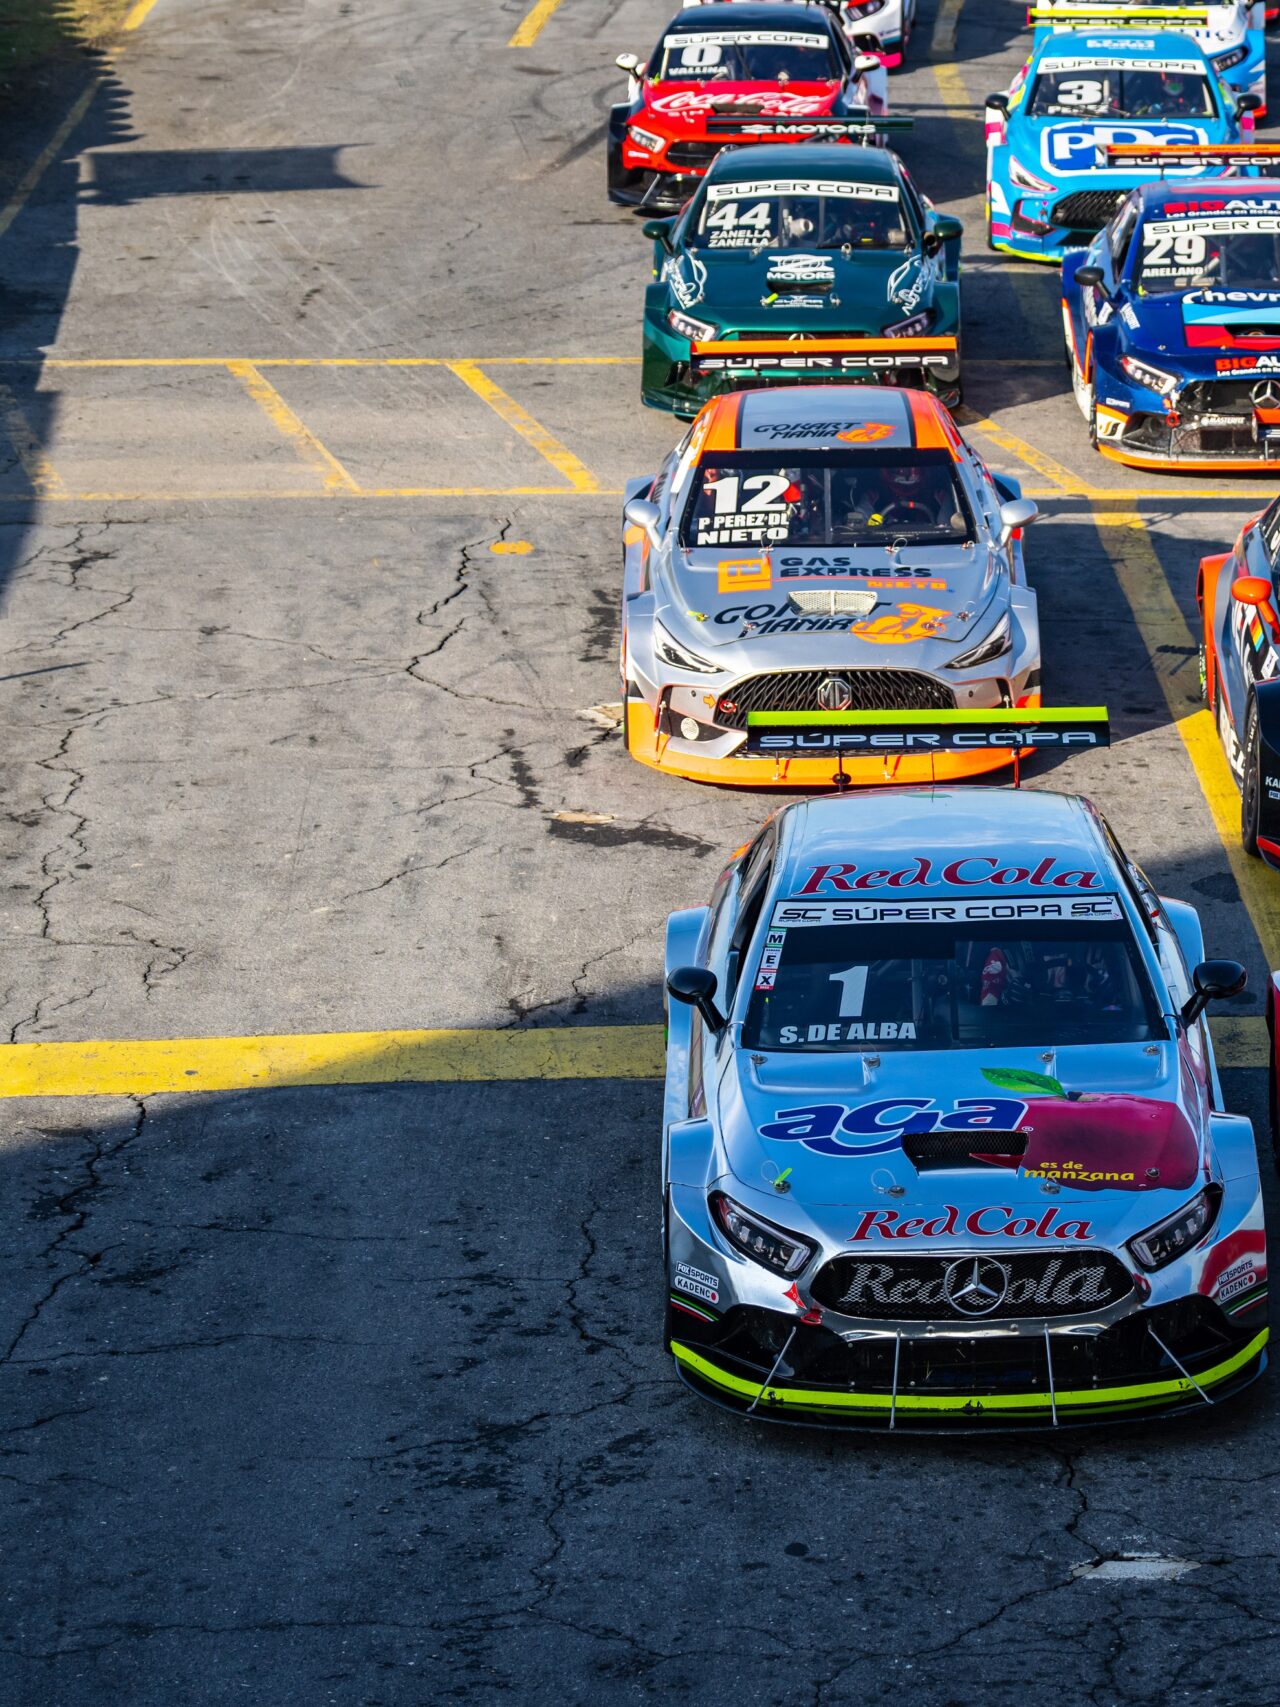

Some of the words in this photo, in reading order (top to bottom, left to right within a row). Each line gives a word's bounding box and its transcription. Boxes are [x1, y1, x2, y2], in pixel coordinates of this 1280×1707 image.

[674, 34, 753, 46] SUPER
[757, 33, 820, 45] COPA
[680, 44, 722, 67] 0
[668, 66, 729, 75] VALLINA
[1045, 59, 1126, 70] SUPER
[1132, 60, 1197, 70] COPA
[1057, 80, 1104, 105] 3
[776, 123, 877, 134] MOTORS
[715, 183, 811, 198] SUPER
[816, 183, 894, 198] COPA
[706, 202, 772, 231] 44
[710, 228, 772, 239] ZANELLA
[1152, 221, 1250, 235] SUPER
[707, 238, 769, 248] ZANELLA
[1143, 235, 1206, 266] 29
[766, 271, 836, 281] MOTORS
[1141, 266, 1205, 279] ARELLANO
[699, 356, 833, 369] SÚPER
[841, 355, 949, 368] COPA
[753, 422, 861, 433] GOKART
[768, 430, 842, 440] MANIA
[703, 475, 791, 515] 12
[698, 517, 711, 530] P
[697, 526, 789, 546] NIETO
[780, 557, 851, 567] GAS
[779, 567, 933, 578] EXPRESS
[866, 580, 948, 590] NIETO
[738, 617, 856, 638] MANIA
[759, 731, 941, 748] SÚPER
[952, 730, 1098, 745] COPA
[779, 908, 828, 920] SC
[832, 906, 956, 922] SÚPER
[964, 903, 1063, 919] COPA
[1071, 901, 1113, 914] SC
[828, 965, 870, 1018] 1
[846, 1022, 917, 1040] ALBA
[1040, 1161, 1059, 1170] es
[1062, 1159, 1084, 1170] de
[1023, 1168, 1135, 1183] manzana
[677, 1262, 691, 1275] FOX
[690, 1269, 718, 1288] SPORTS
[1228, 1260, 1253, 1279] SPORTS
